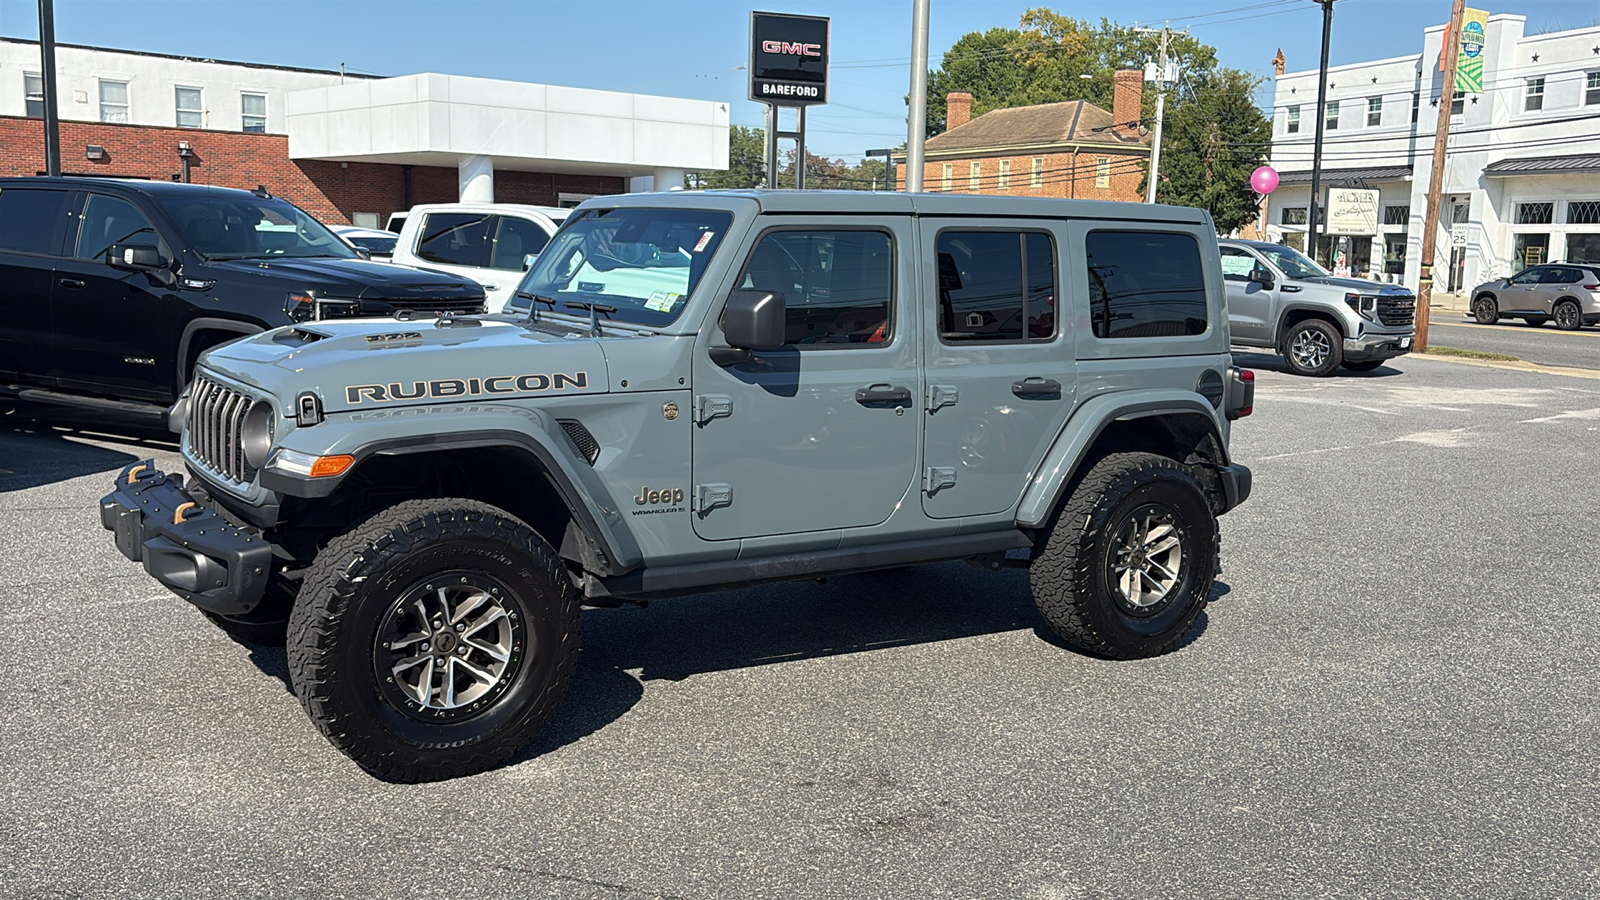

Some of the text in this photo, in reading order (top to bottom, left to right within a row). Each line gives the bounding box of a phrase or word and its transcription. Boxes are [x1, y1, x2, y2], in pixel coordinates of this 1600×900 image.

[763, 40, 821, 56] GMC
[762, 84, 818, 97] BAREFORD
[1453, 235, 1466, 244] 25
[345, 371, 588, 404] RUBICON
[633, 485, 684, 506] Jeep
[631, 507, 678, 516] WRANGLER
